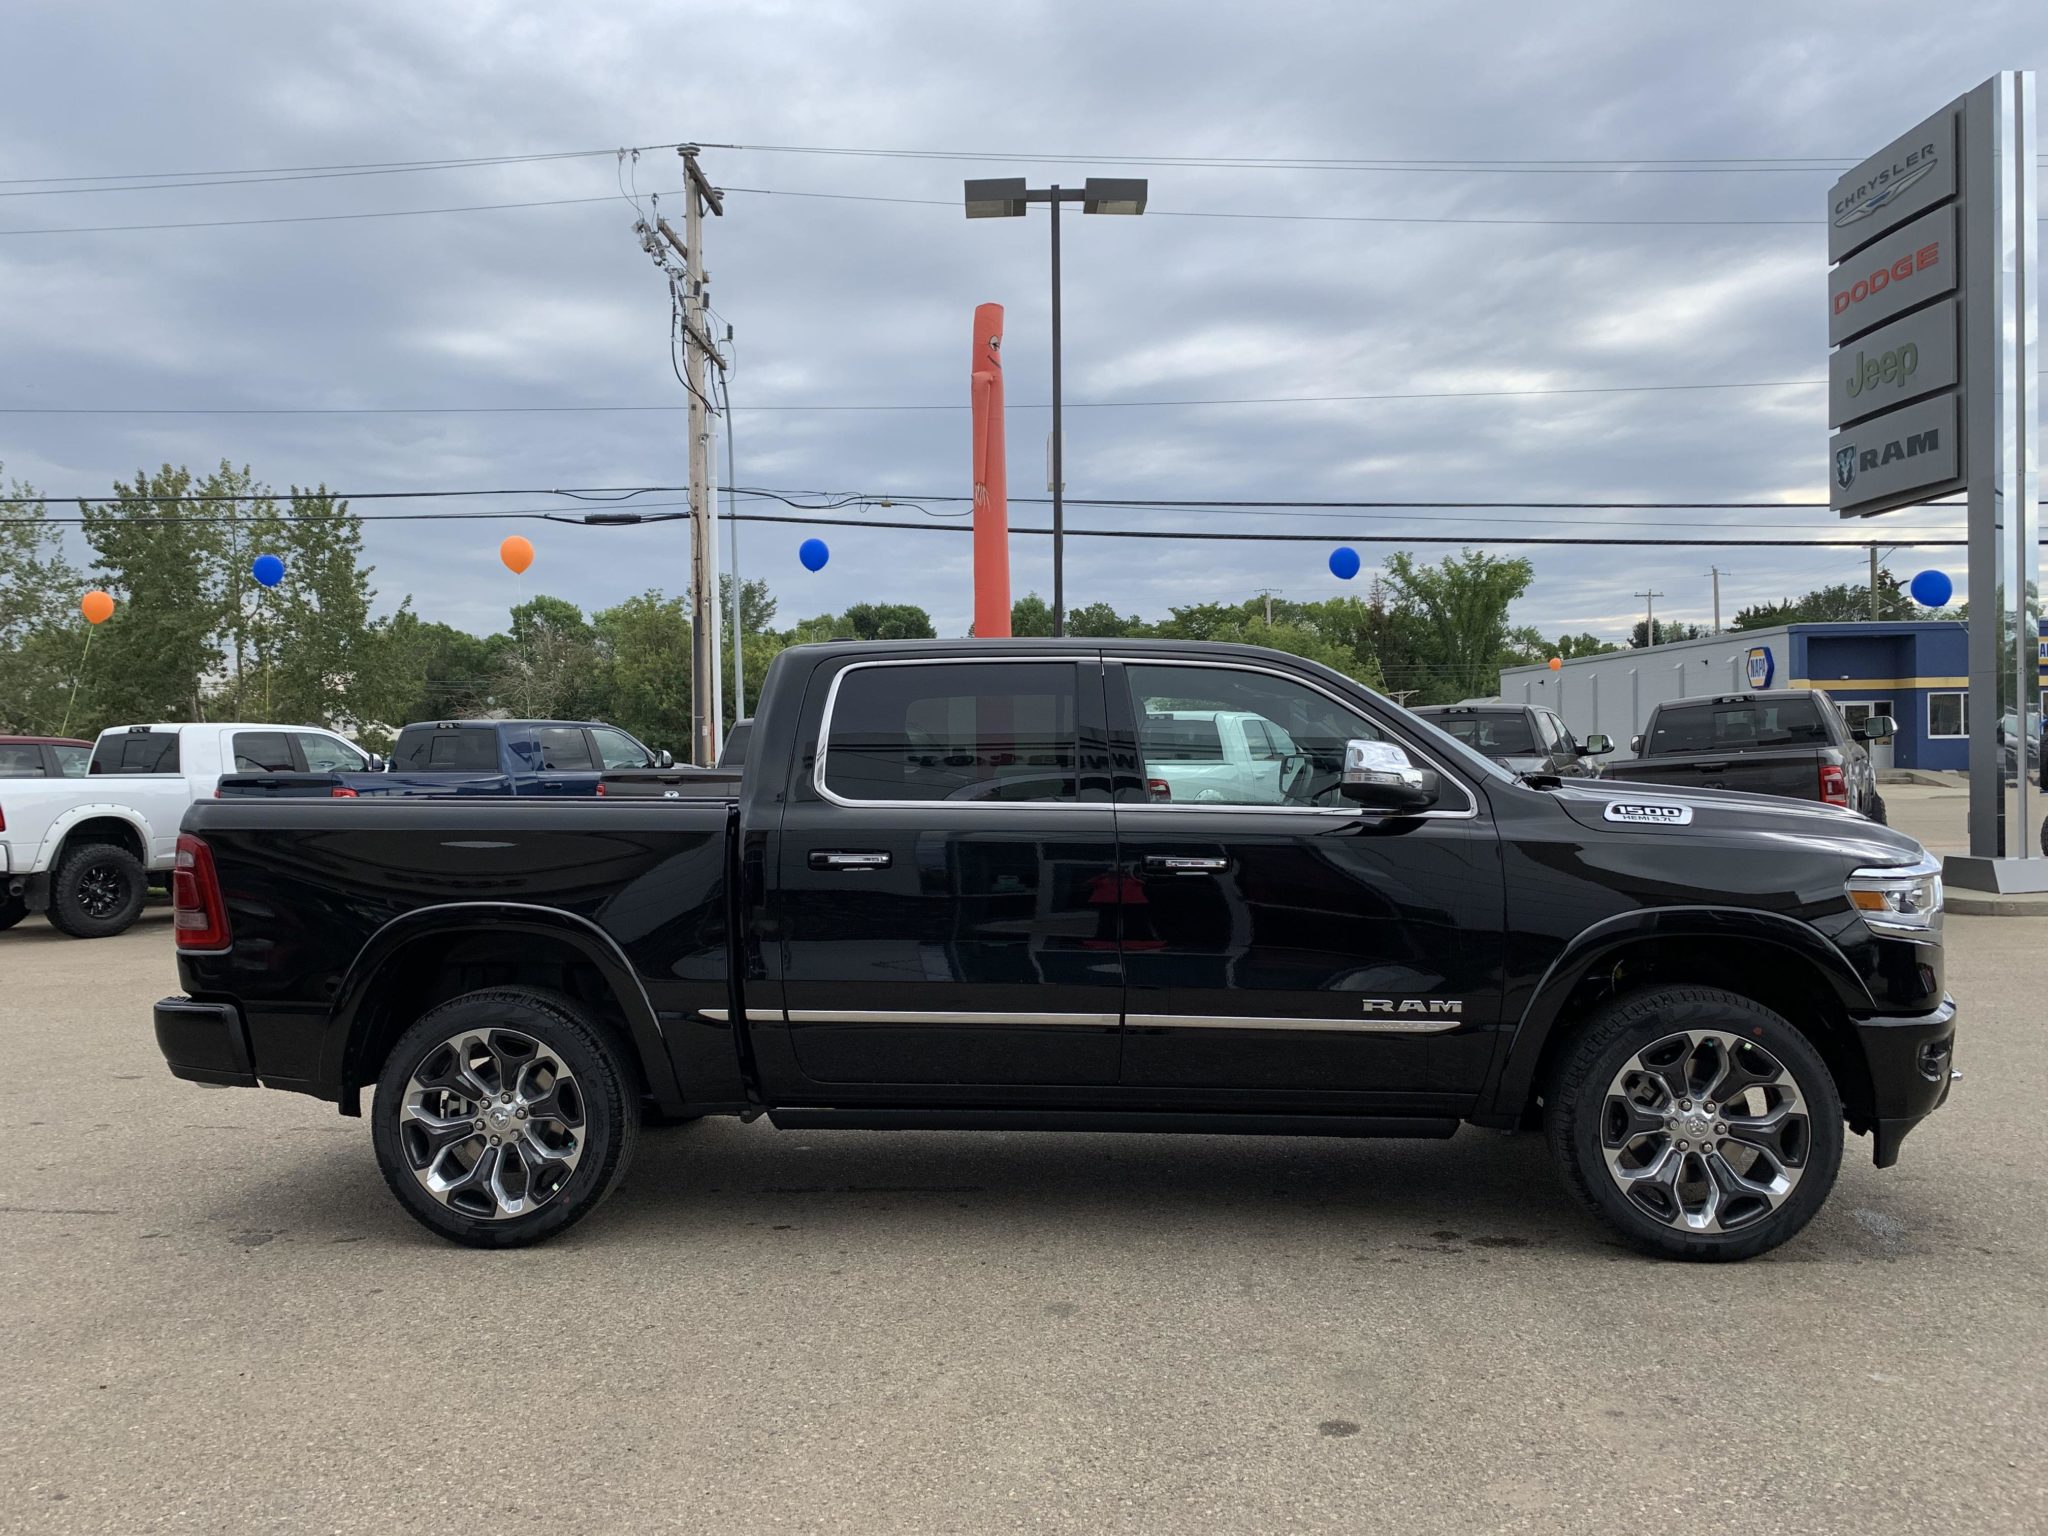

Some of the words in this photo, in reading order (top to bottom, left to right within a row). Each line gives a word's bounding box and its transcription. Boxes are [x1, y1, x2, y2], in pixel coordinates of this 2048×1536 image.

[1835, 143, 1934, 215] CHRYSLER
[1834, 242, 1939, 315] DODGE
[1846, 342, 1919, 398] Jeep
[1859, 428, 1939, 473] RAM
[1750, 657, 1766, 678] NAPA
[1616, 805, 1680, 817] 1500
[1362, 999, 1462, 1013] RAM
